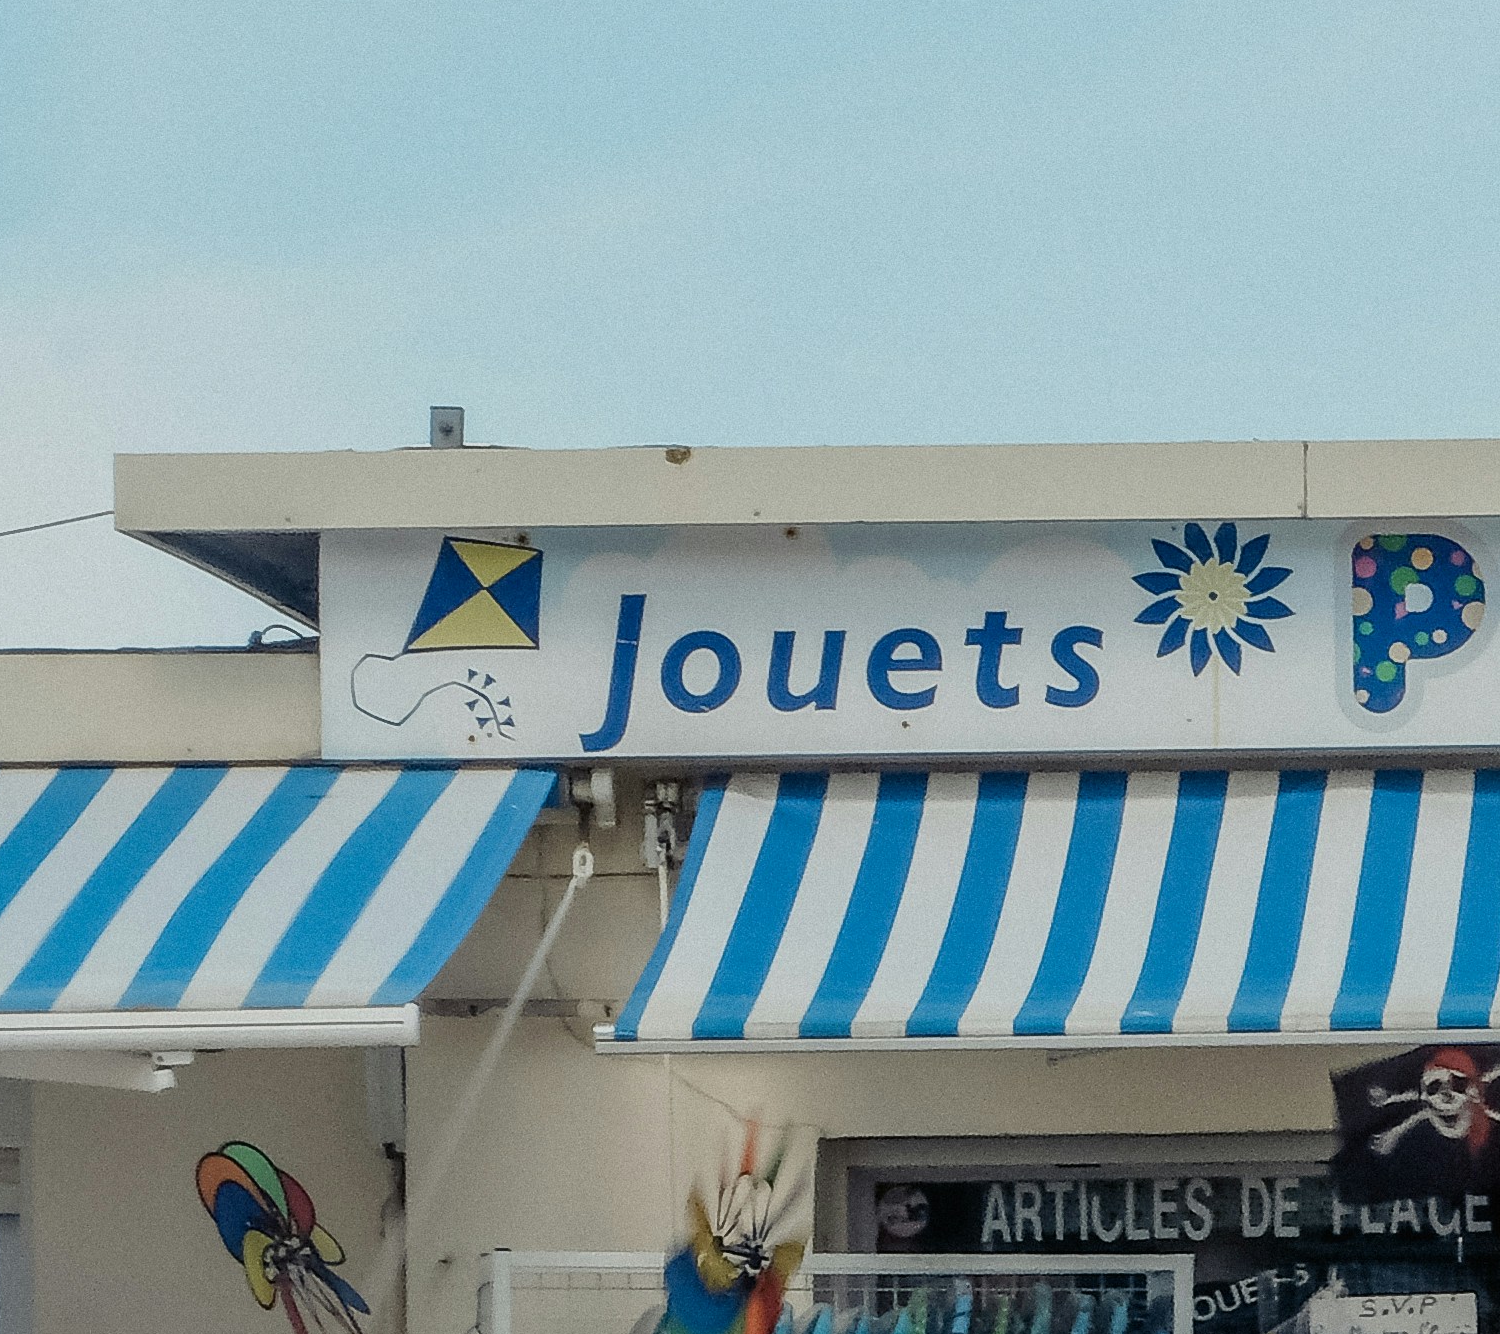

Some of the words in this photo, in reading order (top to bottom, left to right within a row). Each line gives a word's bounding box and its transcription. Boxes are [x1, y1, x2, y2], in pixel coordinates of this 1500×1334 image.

[580, 594, 1105, 753] Jouets
[980, 1178, 1215, 1243] ARTICLES
[1240, 1177, 1301, 1240] DE
